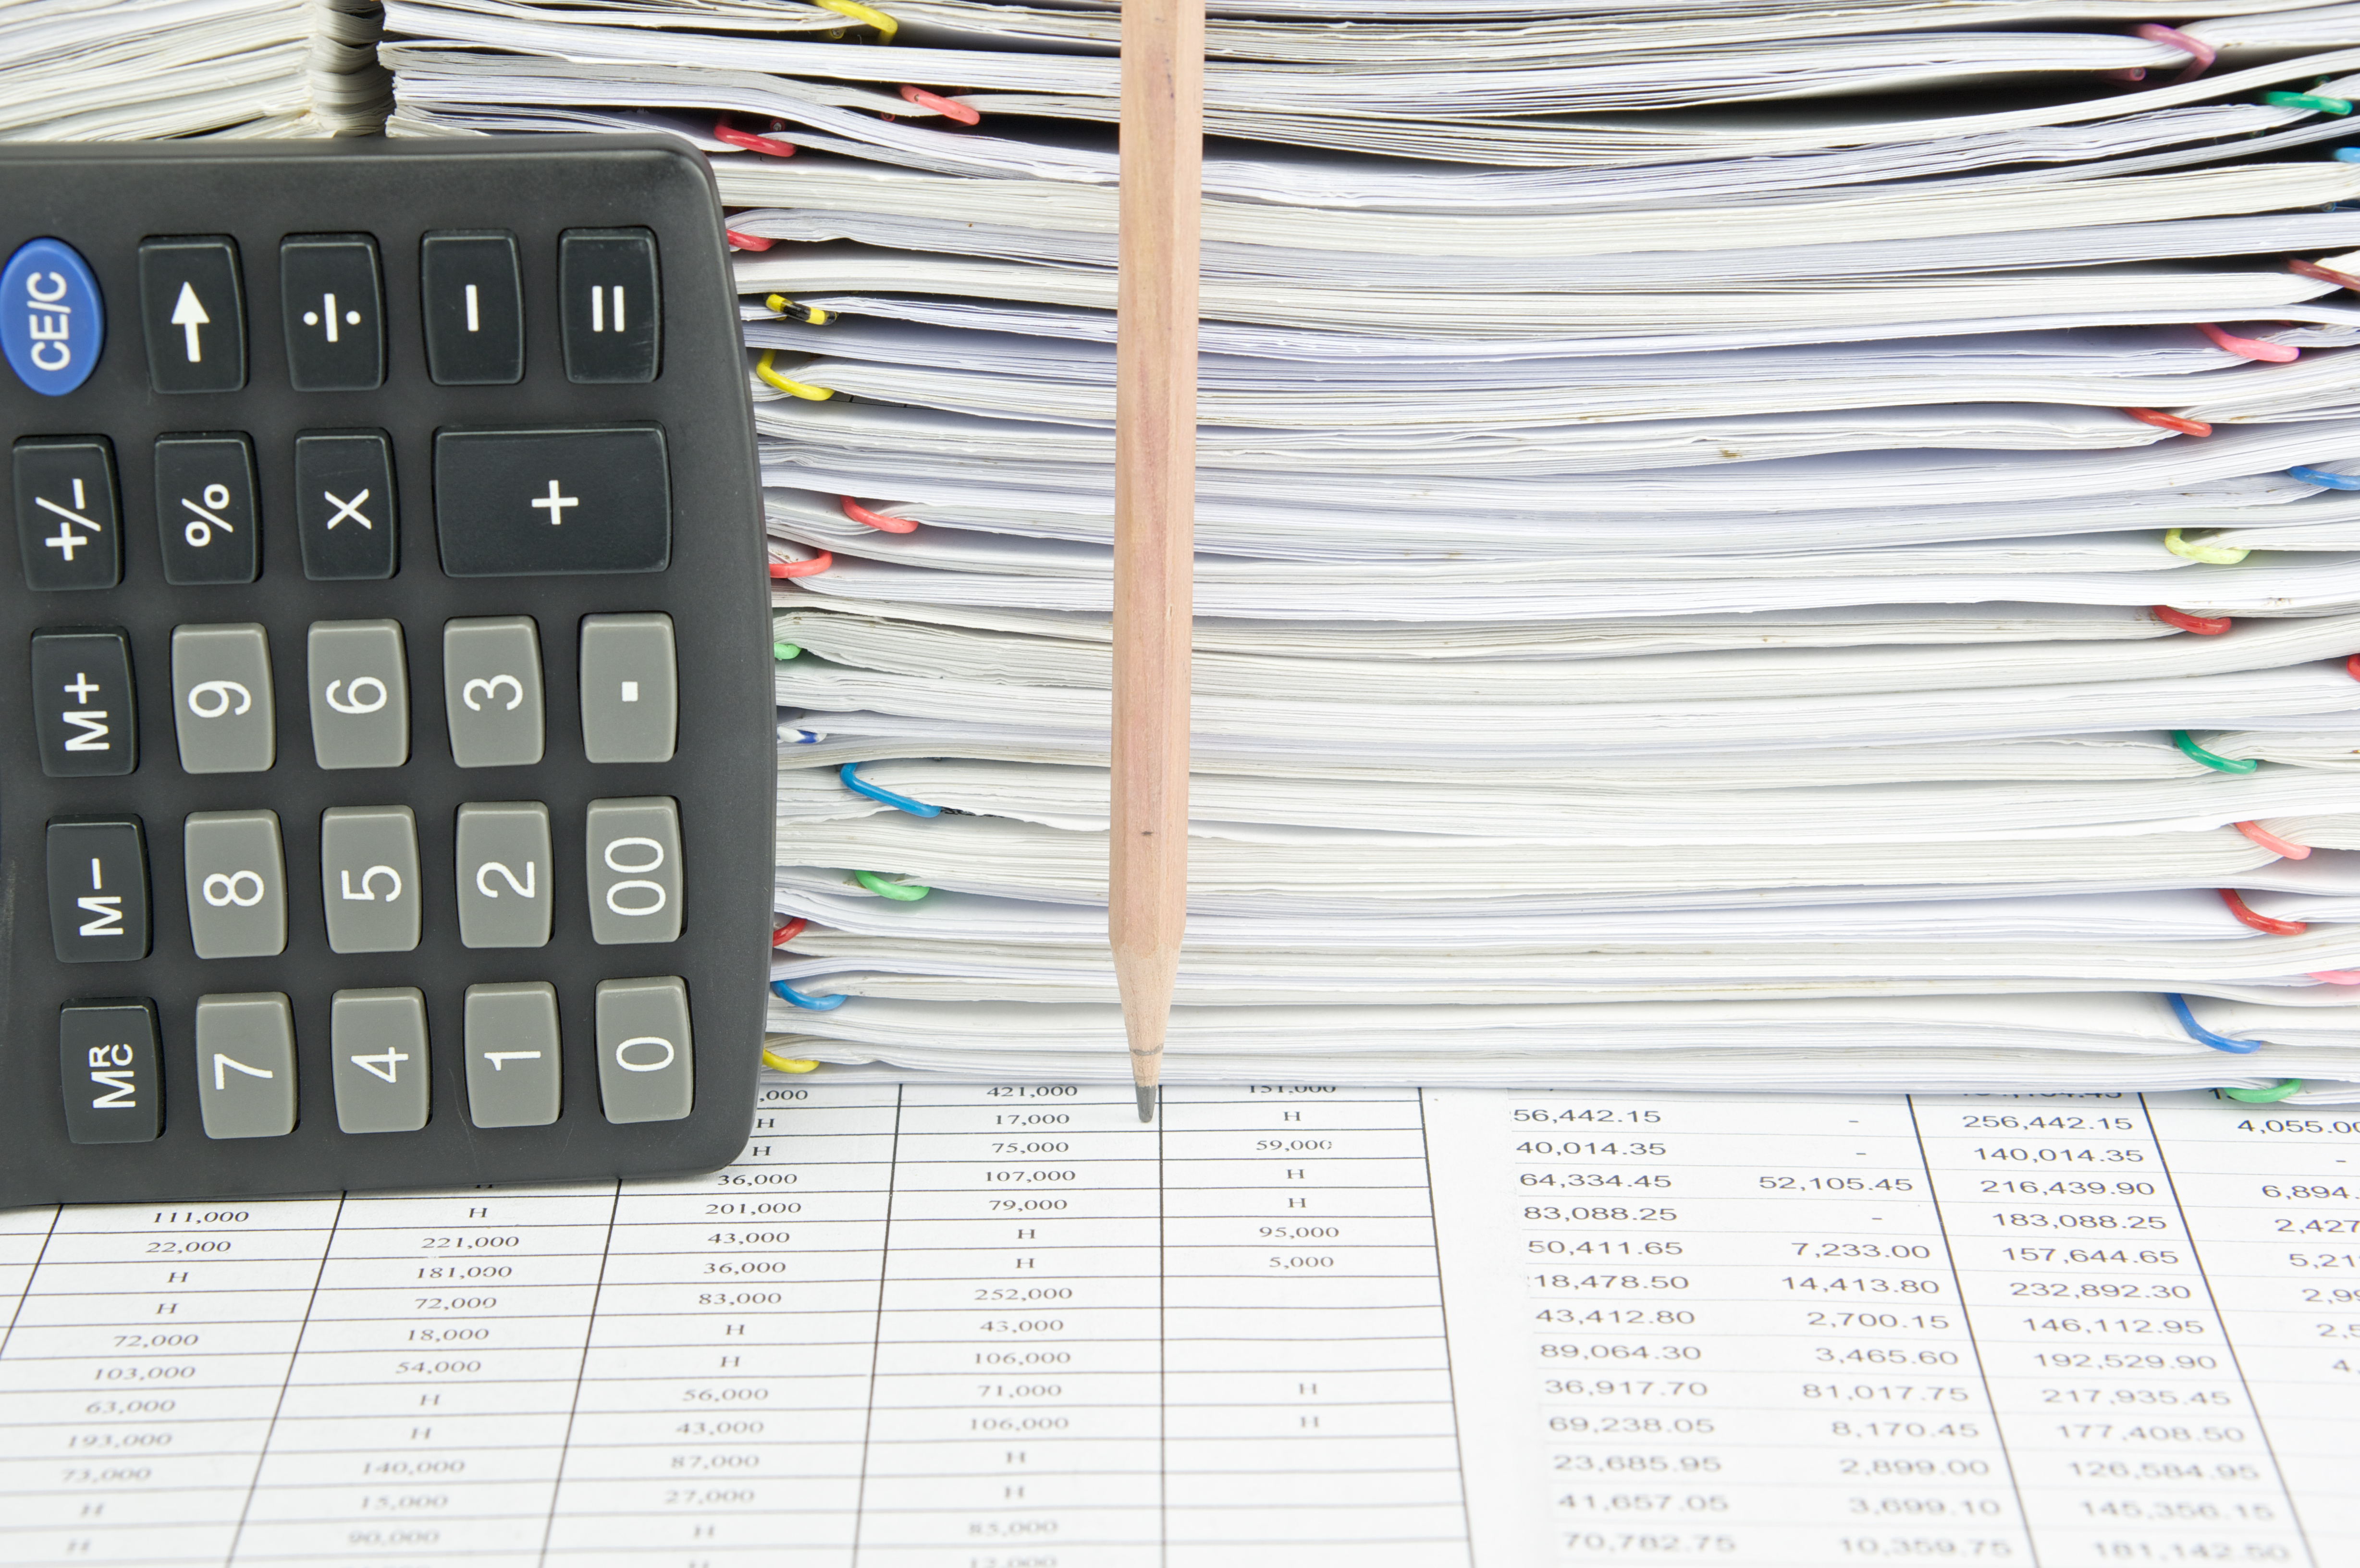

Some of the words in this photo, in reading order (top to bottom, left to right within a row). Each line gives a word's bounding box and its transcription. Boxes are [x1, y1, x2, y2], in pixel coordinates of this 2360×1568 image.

[27, 272, 71, 370] CE/C
[532, 480, 578, 525] +
[182, 484, 233, 547] %
[188, 681, 251, 718] 9
[326, 676, 387, 714] 6
[463, 674, 523, 711] 3
[63, 673, 110, 751] M+
[341, 865, 402, 902] 5
[476, 861, 535, 898] 2
[604, 837, 666, 916] 00
[203, 870, 264, 906] 8
[78, 858, 123, 936] M-
[484, 1051, 541, 1071] 1
[615, 1037, 675, 1072] 0
[214, 1054, 273, 1090] 7
[351, 1047, 409, 1083] 4
[759, 1090, 808, 1102] ,000
[986, 1085, 1078, 1098] 421,000
[756, 1118, 775, 1128] H
[996, 1114, 1070, 1126] 17,000
[1284, 1111, 1301, 1121] H
[1509, 1108, 1662, 1125] 56,442.15
[1962, 1115, 2133, 1130] 256,442.15
[752, 1146, 771, 1156] H
[992, 1142, 1069, 1154] 75,000
[1256, 1140, 1332, 1152] 59,000
[1516, 1141, 1666, 1156] 40,014.35
[1974, 1148, 2144, 1163] 140,014.35
[717, 1174, 798, 1186] 36,000
[986, 1170, 1076, 1183] 107,000
[1287, 1169, 1304, 1179] H
[1520, 1173, 1672, 1188] 64,334.45
[1759, 1176, 1913, 1191] 52,105.45
[1980, 1180, 2155, 1196] 216,439.90
[2262, 1185, 2360, 1200] 6,894.
[705, 1202, 801, 1215] 201,000
[989, 1200, 1068, 1212] 79,000
[1289, 1198, 1306, 1208] H
[154, 1211, 249, 1224] 111,000
[469, 1207, 488, 1218] H
[1524, 1206, 1677, 1222] 83,088.25
[1992, 1213, 2167, 1229] 183,088.25
[708, 1232, 790, 1245] 43,000
[1018, 1229, 1035, 1239] H
[1259, 1227, 1340, 1239] 95,000
[146, 1241, 231, 1254] 22,000
[421, 1236, 519, 1250] 221,000
[1528, 1240, 1683, 1256] 50,411.65
[1791, 1243, 1930, 1259] 7,233.00
[2003, 1248, 2179, 1264] 157,644.65
[703, 1262, 786, 1275] 36,000
[1016, 1258, 1034, 1269] H
[1269, 1257, 1334, 1269] 5,000
[2289, 1253, 2360, 1269] 5,21
[167, 1272, 188, 1283] H
[418, 1266, 512, 1279] 181,000
[1527, 1274, 1689, 1290] 18,478.50
[1782, 1276, 1940, 1294] 14,413.80
[974, 1288, 1073, 1301] 252,000
[2010, 1282, 2191, 1299] 232,892.30
[415, 1297, 497, 1311] 72,000
[699, 1293, 782, 1306] 83,000
[156, 1303, 178, 1314] H
[1536, 1309, 1695, 1325] 43,412.80
[1807, 1312, 1949, 1329] 2,700.15
[726, 1324, 745, 1335] H
[980, 1320, 1064, 1334] 43,000
[2023, 1318, 2204, 1334] 146,112.95
[114, 1334, 199, 1348] 72,000
[408, 1329, 490, 1342] 18,000
[976, 1352, 1071, 1366] 106,000
[1540, 1344, 1701, 1360] 89,064.30
[1816, 1348, 1958, 1365] 3,465.60
[396, 1361, 481, 1374] 54,000
[721, 1356, 740, 1368] H
[2034, 1353, 2217, 1370] 192,529.90
[95, 1366, 196, 1381] 103,000
[683, 1389, 769, 1402] 56,000
[978, 1385, 1062, 1398] 71,000
[1299, 1383, 1317, 1395] H
[1545, 1380, 1708, 1396] 36,917.70
[1802, 1384, 1968, 1401] 81,017.75
[420, 1394, 440, 1406] H
[2041, 1389, 2231, 1405] 217,935.45
[86, 1398, 176, 1415] 63,000
[676, 1421, 764, 1436] 43,000
[971, 1418, 1069, 1432] 106,000
[1300, 1416, 1319, 1428] H
[1548, 1416, 1715, 1433] 69,238.05
[1831, 1421, 1979, 1438] 8,170.45
[68, 1433, 173, 1448] 193,000
[411, 1427, 431, 1440] H
[2056, 1424, 2245, 1443] 177,408.50
[671, 1455, 760, 1470] 87,000
[1006, 1451, 1026, 1464] H
[1554, 1455, 1721, 1472] 23,685.95
